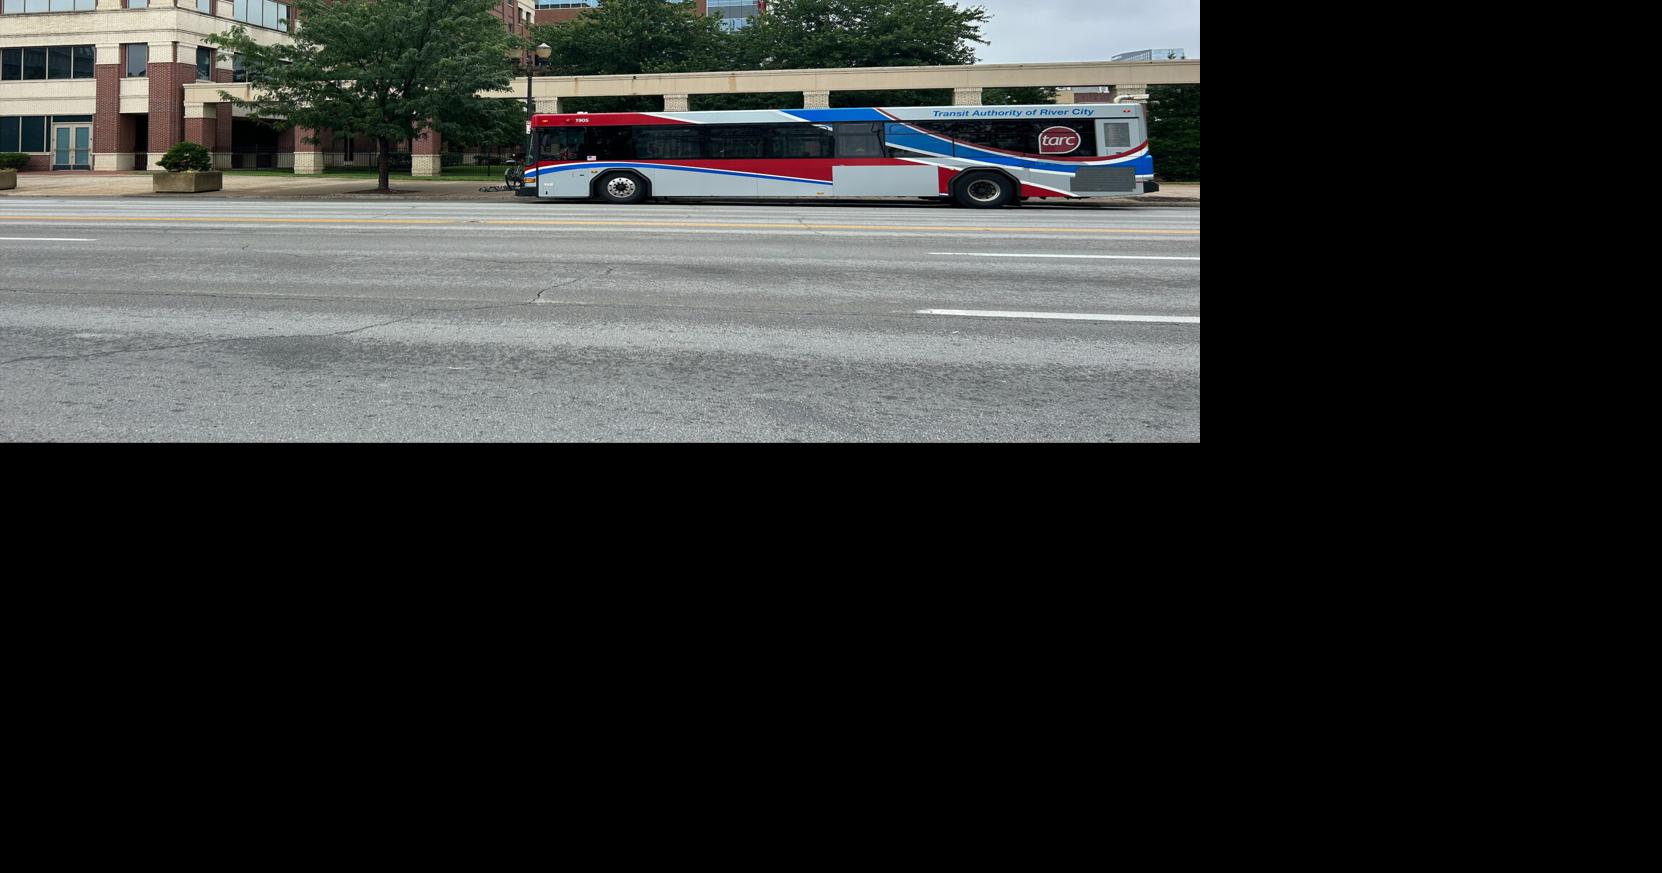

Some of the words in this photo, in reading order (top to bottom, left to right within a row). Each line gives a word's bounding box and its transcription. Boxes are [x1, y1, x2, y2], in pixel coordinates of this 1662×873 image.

[972, 109, 1023, 117] Authority
[1040, 108, 1069, 116] River
[1072, 108, 1095, 117] City
[1042, 134, 1075, 146] tarc
